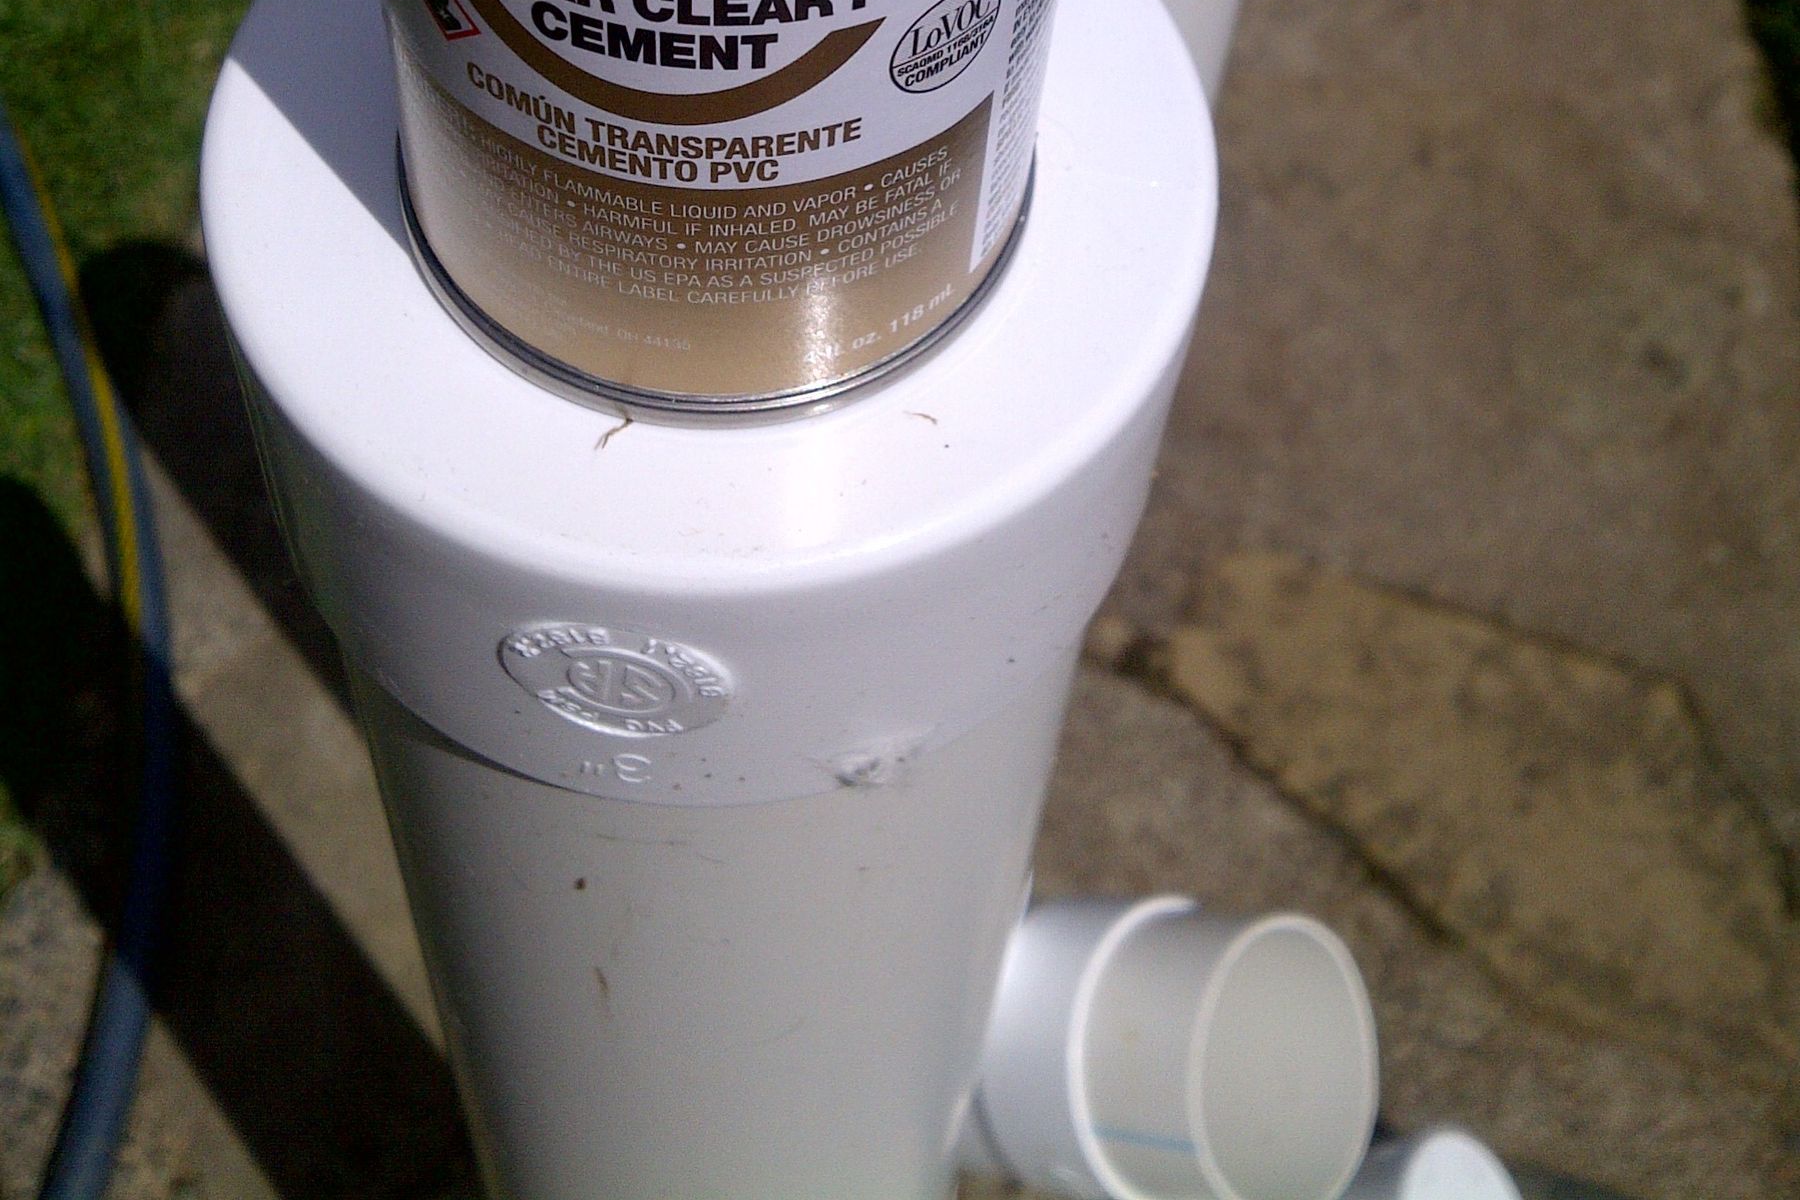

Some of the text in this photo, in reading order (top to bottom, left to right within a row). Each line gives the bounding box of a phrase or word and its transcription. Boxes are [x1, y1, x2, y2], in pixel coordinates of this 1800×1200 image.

[530, 0, 779, 70] CEMENT
[905, 30, 987, 87] COMPLIANT
[466, 61, 576, 135] COMÚN
[584, 117, 862, 159] TRANSPARENTE
[537, 125, 779, 183] CEMENTO PVC
[543, 169, 663, 215] FLAMMABLE
[670, 203, 736, 219] LIQUID
[743, 201, 785, 218] AND
[792, 185, 856, 213] VAPOR
[880, 145, 948, 191] CAUSES
[569, 231, 697, 270] RESPIRATORY
[706, 248, 811, 271] IRRITATION
[837, 204, 928, 256] CONTAINS
[931, 193, 943, 214] A
[582, 219, 667, 250] AIRWAYS
[695, 241, 737, 253] MAY
[744, 232, 809, 253] CAUSE
[817, 185, 936, 243] DROWSINESS
[939, 165, 961, 194] OR
[583, 202, 676, 234] HARMFUL
[685, 223, 701, 236] IF
[710, 217, 795, 237] INHALED
[809, 204, 849, 227] MAY
[855, 194, 878, 215] BE
[884, 172, 934, 203] FATAL
[939, 156, 952, 178] IF
[588, 254, 622, 276] THE
[630, 265, 656, 283] US
[664, 272, 701, 287] EPA
[707, 275, 733, 288] AS
[739, 274, 752, 287] A
[760, 248, 874, 286] SUSPECTED
[880, 200, 959, 256] POSSIBLE
[618, 279, 678, 303] LABEL
[687, 284, 799, 304] CAREFULLY
[890, 303, 924, 333] 118
